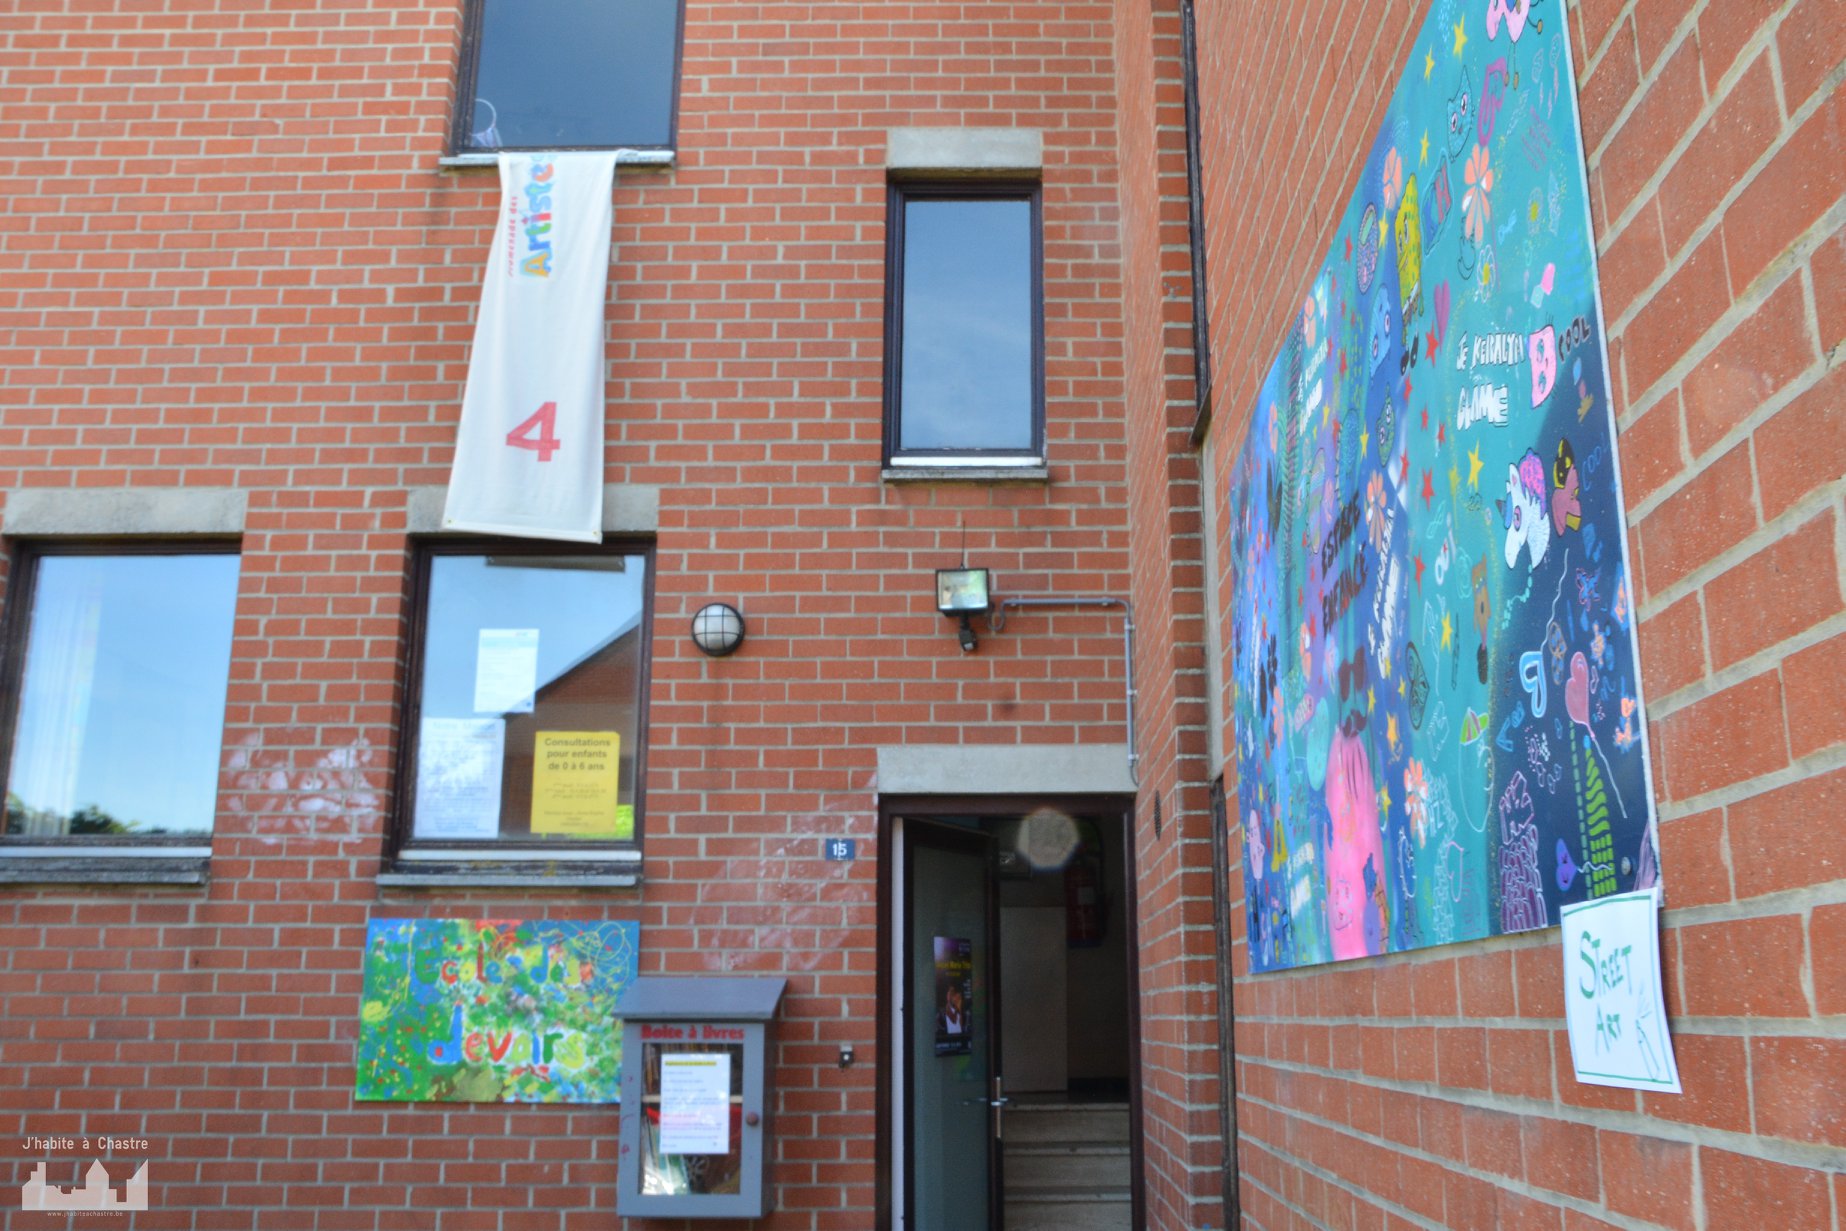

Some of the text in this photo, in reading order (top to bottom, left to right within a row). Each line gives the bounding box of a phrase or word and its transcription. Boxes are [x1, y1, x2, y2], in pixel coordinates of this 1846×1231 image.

[505, 402, 561, 462] 4
[544, 738, 611, 747] Consultations
[547, 749, 608, 759] pour enfants
[548, 761, 560, 770] de
[571, 761, 577, 770] à
[579, 761, 585, 770] 6
[832, 842, 848, 857] 15
[426, 1003, 586, 1070] devoirs
[687, 1024, 698, 1039] à
[702, 1024, 745, 1040] livres
